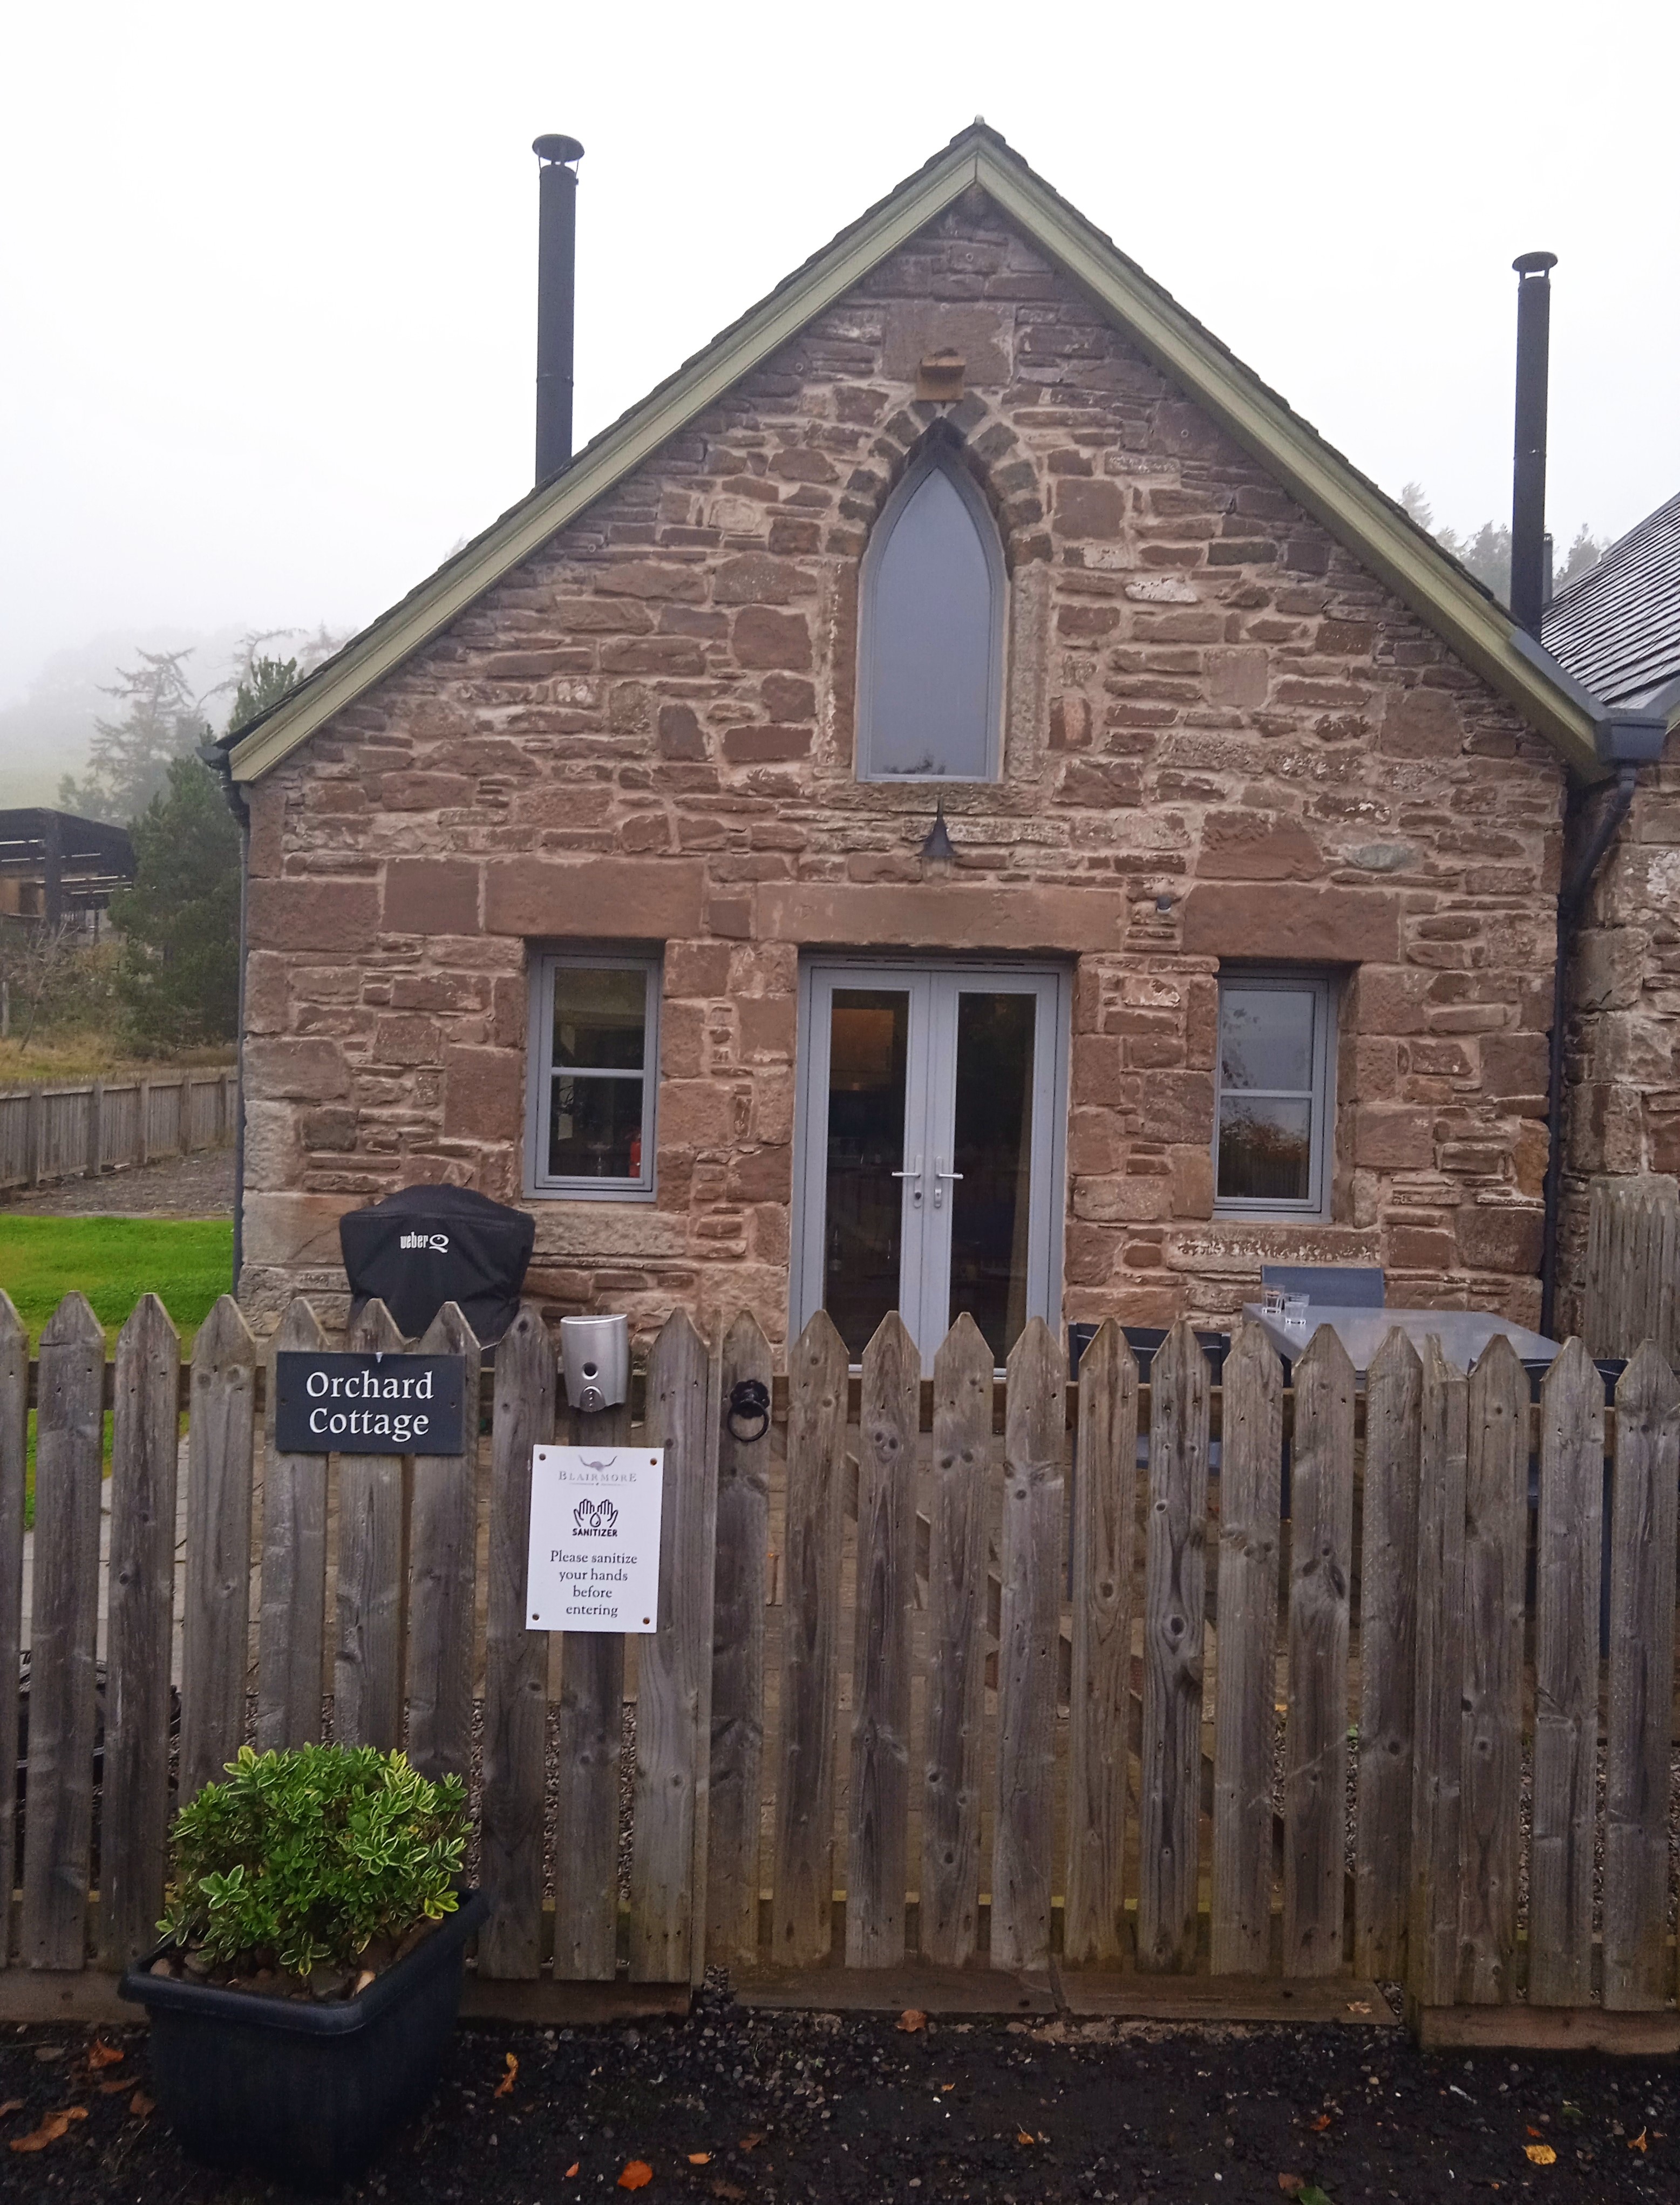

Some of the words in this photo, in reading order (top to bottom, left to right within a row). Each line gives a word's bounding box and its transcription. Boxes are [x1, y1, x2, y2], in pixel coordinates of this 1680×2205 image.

[306, 1370, 434, 1399] Orchard
[309, 1407, 429, 1442] Cottage
[559, 1471, 637, 1482] BLAIRMORE
[572, 1528, 618, 1537] SANITIZER
[550, 1549, 588, 1562] Please
[591, 1553, 637, 1564] sanitize
[559, 1571, 588, 1582] your
[590, 1568, 628, 1581] hands
[573, 1584, 613, 1598] before
[566, 1604, 618, 1618] entering
